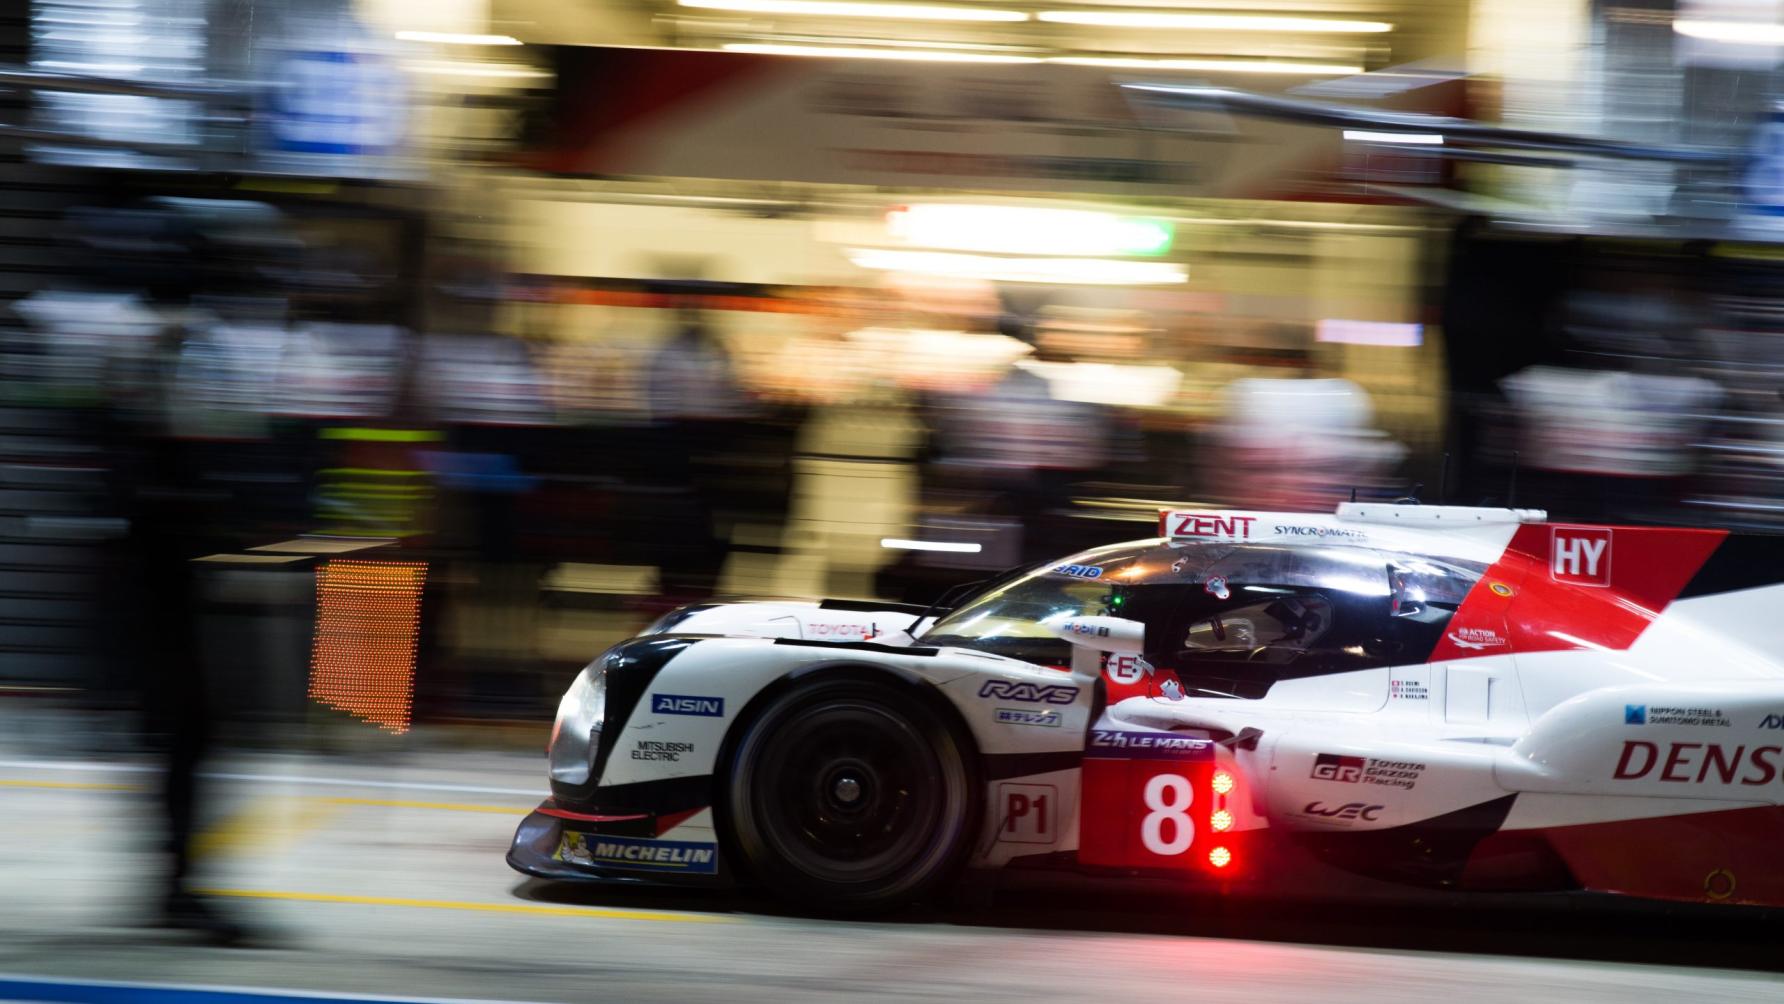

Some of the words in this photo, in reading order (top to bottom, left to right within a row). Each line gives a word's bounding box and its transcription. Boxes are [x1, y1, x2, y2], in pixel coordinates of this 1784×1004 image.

[1174, 514, 1256, 538] ZENT
[1555, 537, 1607, 576] HY
[809, 623, 868, 636] TOYOTA
[979, 680, 1080, 705] RAYS
[657, 698, 719, 713] AISIN
[638, 741, 694, 753] MITSUBISHI
[1129, 737, 1153, 748] LE
[1153, 738, 1207, 750] MANS
[631, 750, 680, 762] ELECTRIC
[1369, 758, 1426, 771] TOYOTA
[1612, 740, 1784, 786] DENS
[1312, 763, 1363, 783] GR
[1362, 776, 1415, 790] Racing
[1366, 767, 1419, 779] GAZOO
[1007, 793, 1049, 834] P1
[1141, 773, 1196, 856] 8
[1303, 801, 1385, 821] WEC
[595, 842, 713, 864] MICHELIN
